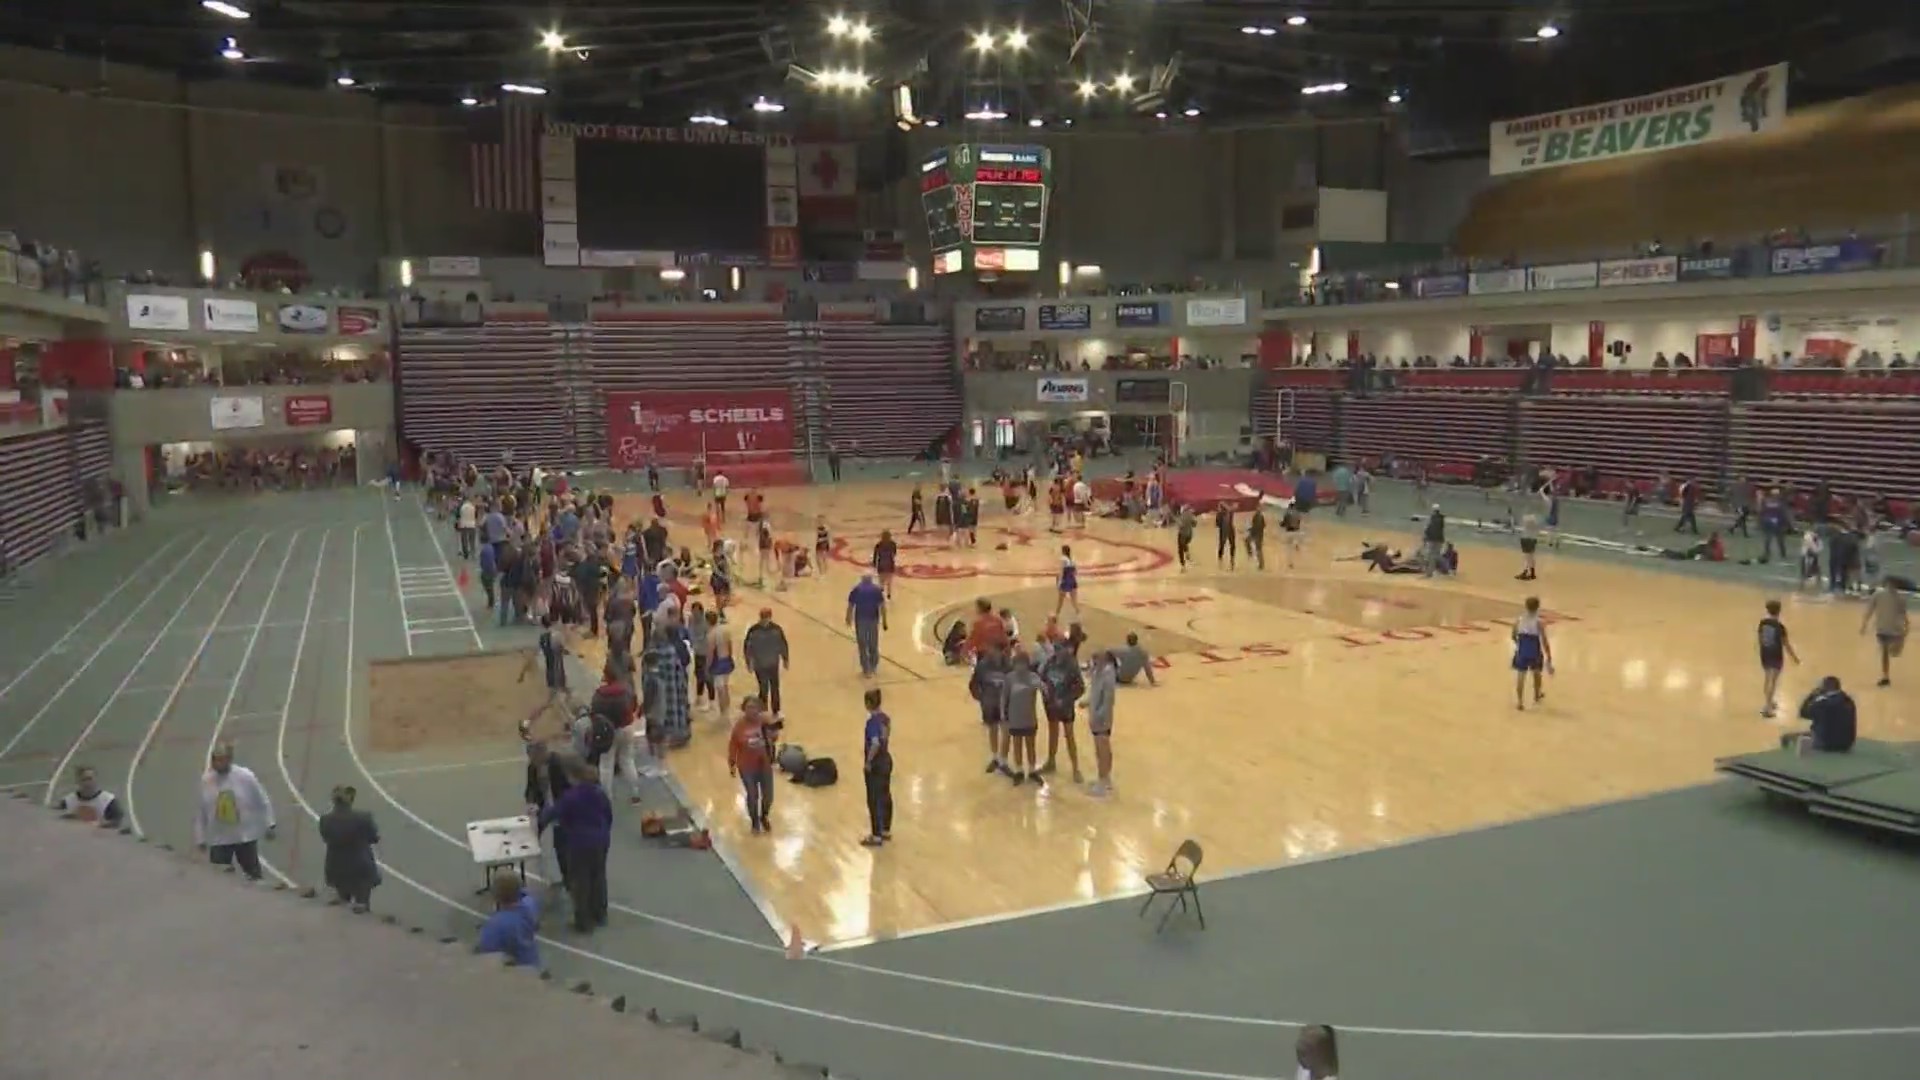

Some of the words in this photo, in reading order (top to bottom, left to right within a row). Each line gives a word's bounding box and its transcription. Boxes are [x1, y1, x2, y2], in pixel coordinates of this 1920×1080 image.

[1569, 105, 1615, 127] STATE
[1623, 81, 1726, 117] UNIVERSITY
[544, 123, 610, 139] MINOT
[616, 126, 680, 142] STATE
[684, 127, 796, 148] UNIVERSITY
[1543, 104, 1715, 163] BEAVERS
[954, 184, 972, 237] MSU
[688, 407, 785, 424] SCHEELS
